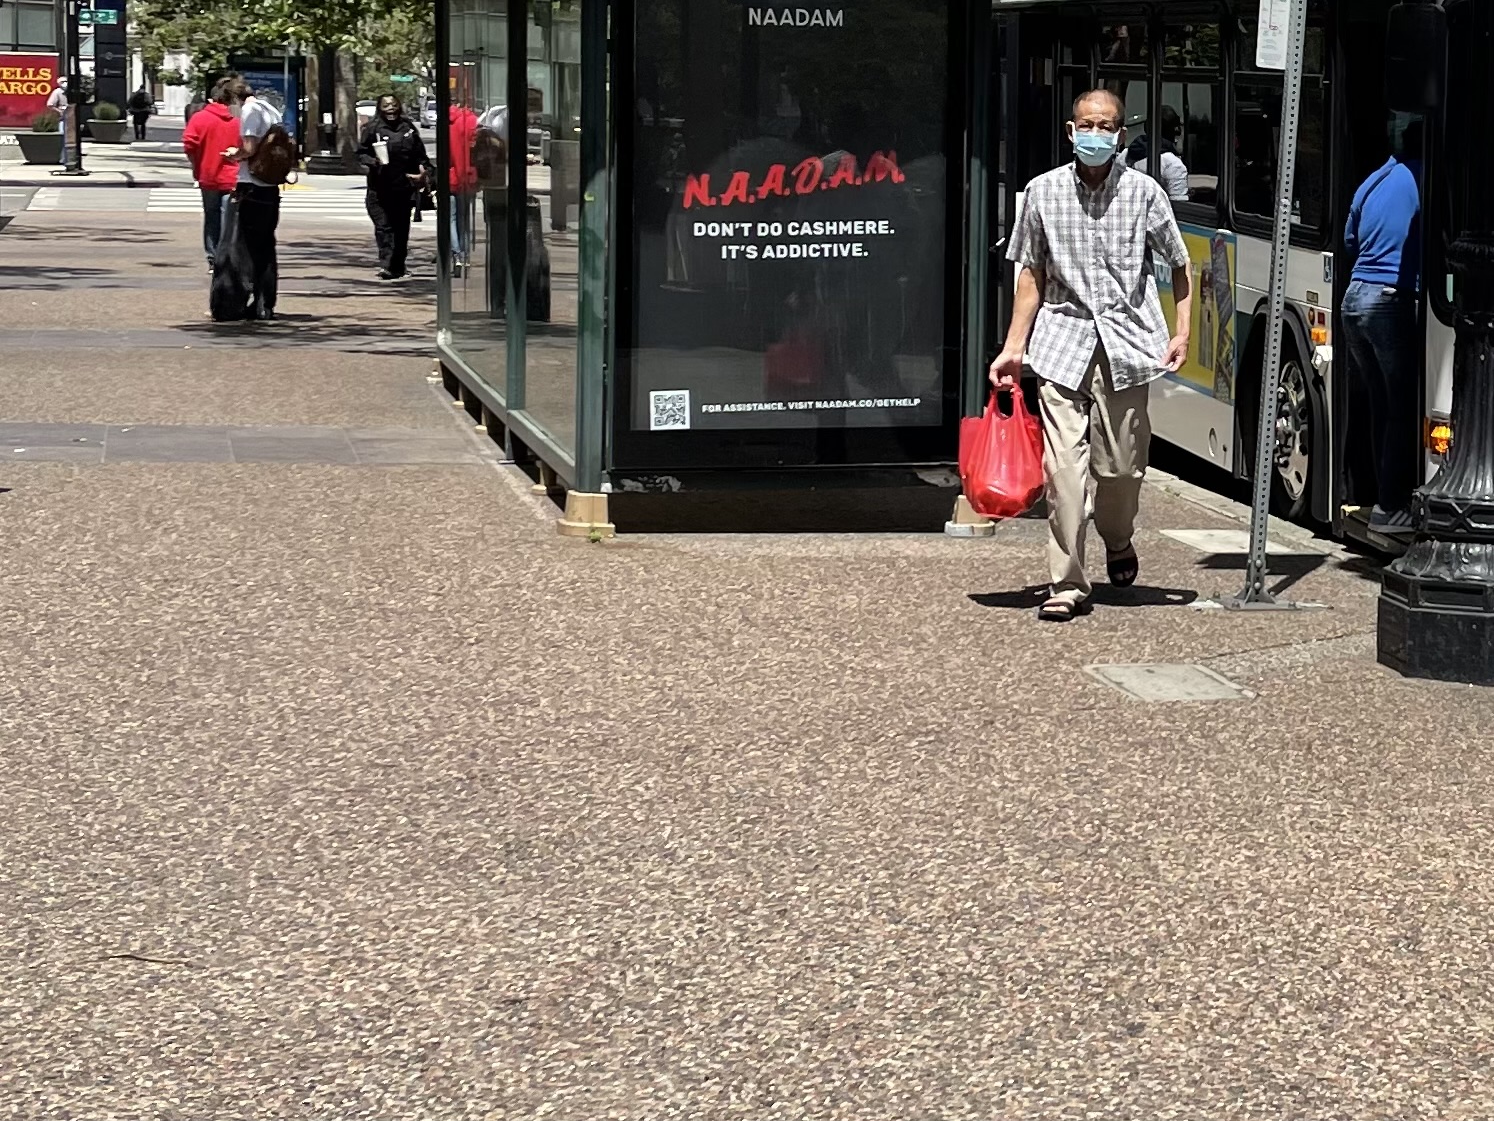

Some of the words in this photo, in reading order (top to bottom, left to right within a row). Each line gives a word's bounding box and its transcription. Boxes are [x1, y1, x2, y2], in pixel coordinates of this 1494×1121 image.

[748, 7, 844, 27] NAADAM
[0, 67, 52, 81] ELLS
[682, 149, 906, 209] N.A.A.D.A.M.
[693, 221, 752, 237] DON'T
[756, 221, 783, 237] DO
[787, 220, 895, 236] CASHMERE.
[721, 244, 759, 260] IT'S
[762, 243, 869, 259] ADDICTIVE.
[702, 404, 722, 413] FOR
[788, 401, 814, 410] VISIT
[815, 398, 921, 409] NAADAM.CO/GETHELP
